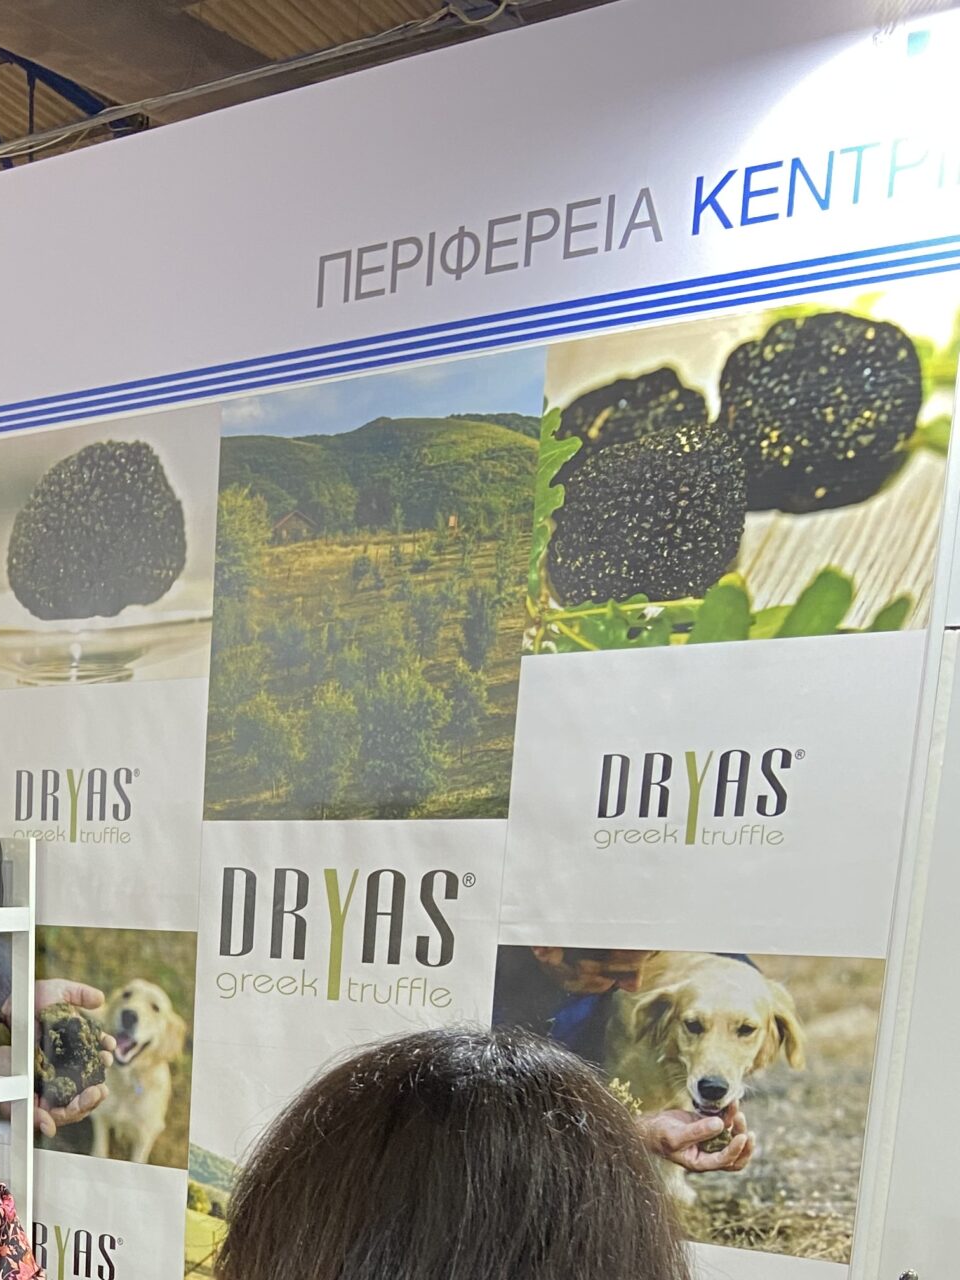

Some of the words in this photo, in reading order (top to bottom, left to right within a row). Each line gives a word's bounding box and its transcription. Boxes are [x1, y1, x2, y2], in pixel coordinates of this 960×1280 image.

[316, 187, 663, 308] ΠΕΡΙΦΕΡΕΙΑ
[691, 137, 960, 237] ΚΕΝΤΡΙ
[80, 827, 132, 844] truffle
[593, 823, 678, 850] greek
[701, 823, 785, 847] truffle
[216, 968, 318, 1000] greek
[347, 976, 453, 1009] truffle
